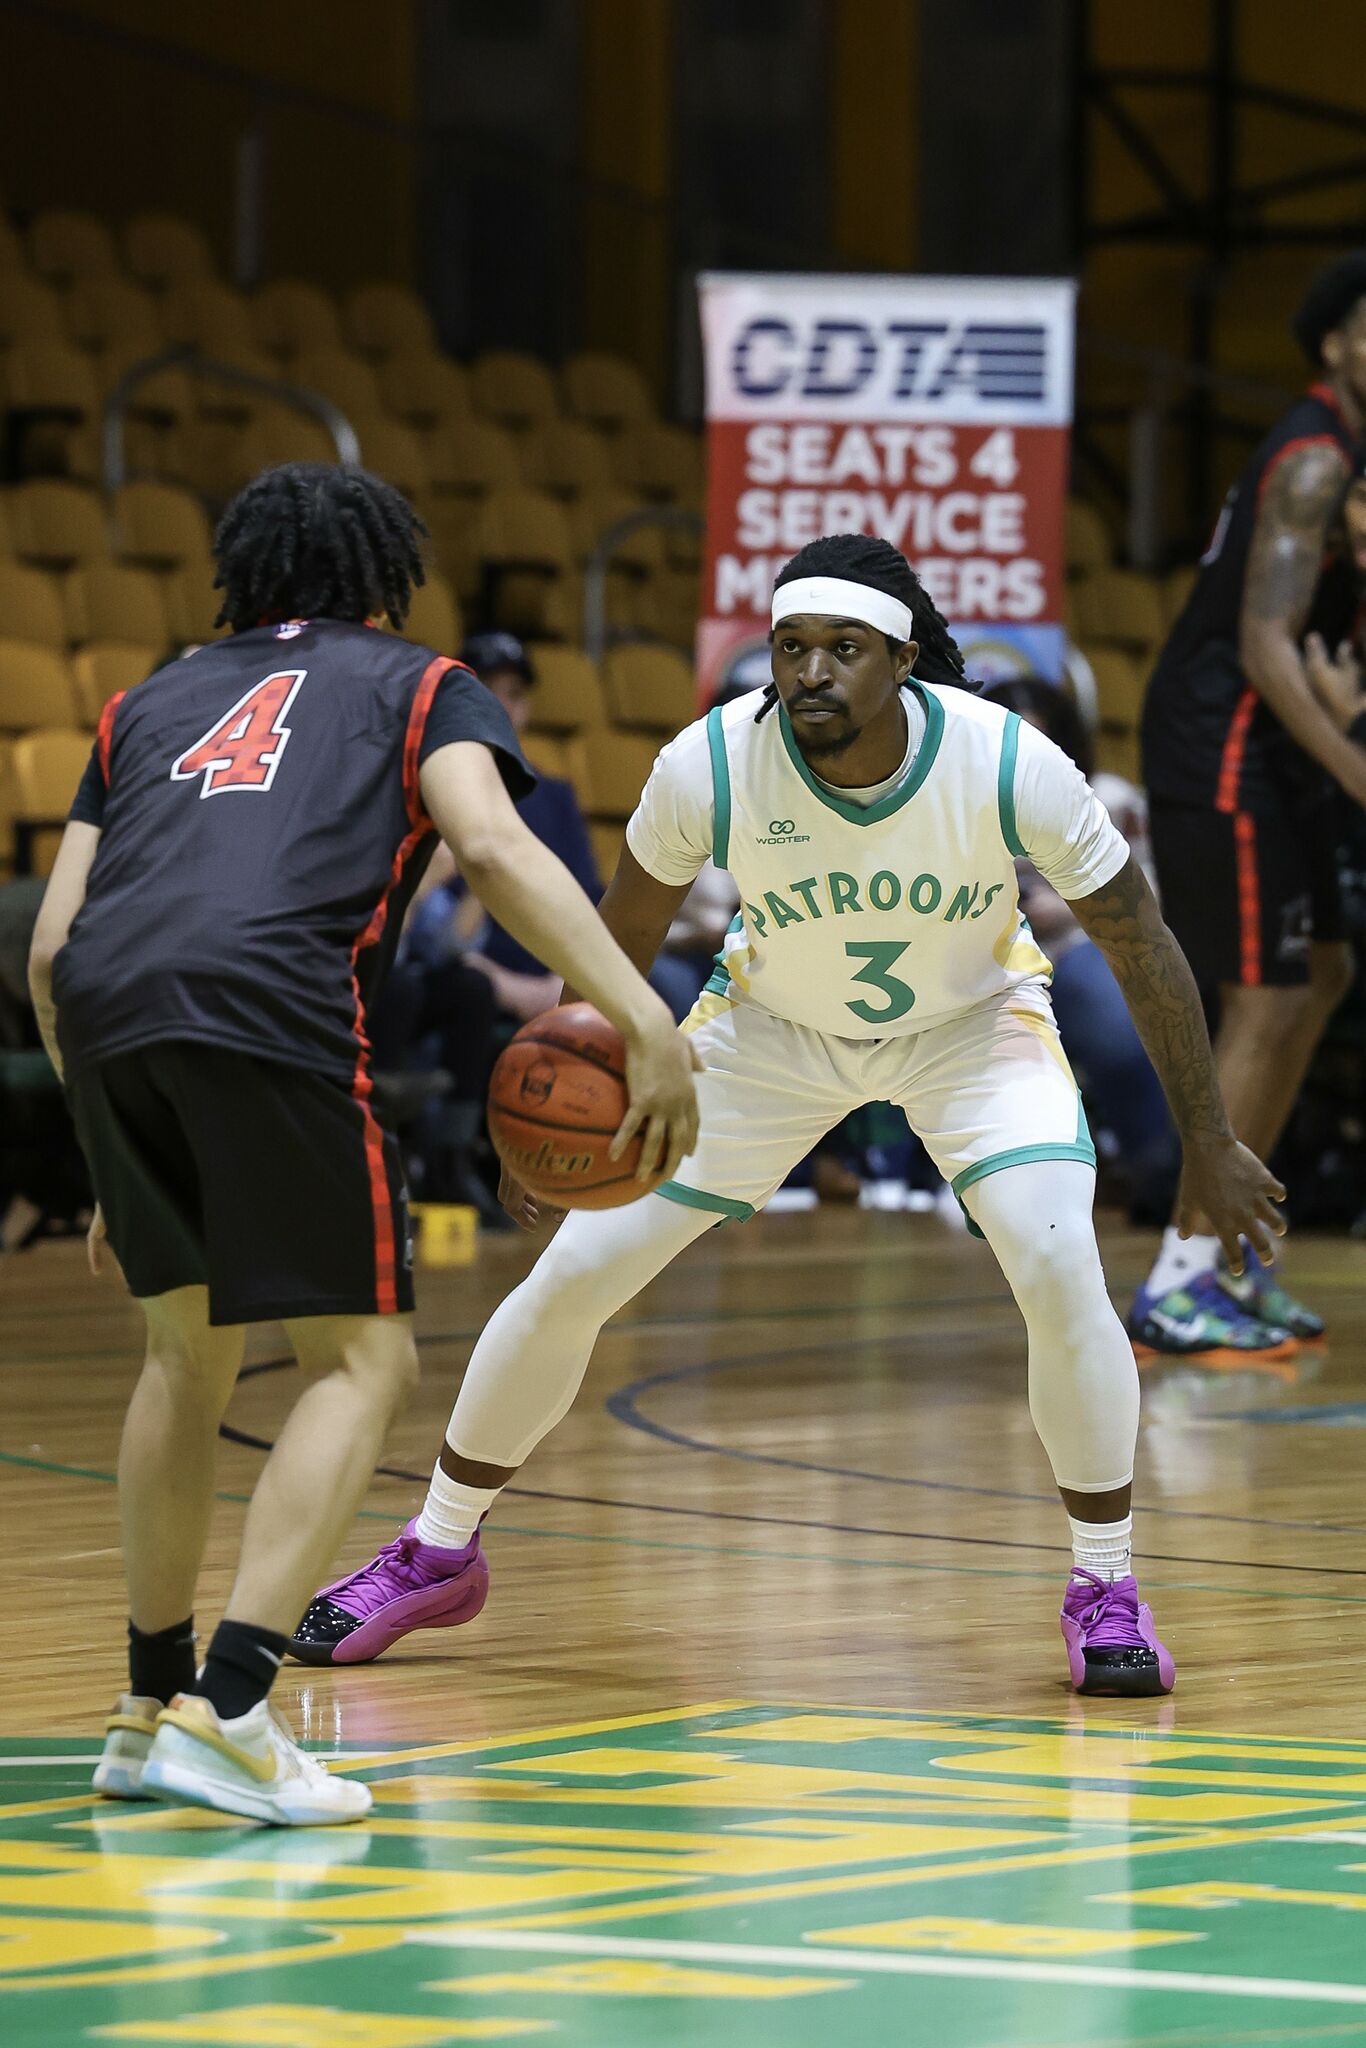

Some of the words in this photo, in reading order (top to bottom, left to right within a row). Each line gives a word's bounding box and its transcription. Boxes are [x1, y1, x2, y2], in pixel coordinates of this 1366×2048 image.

[735, 320, 1045, 397] CDTA
[745, 425, 958, 487] SEATS
[969, 427, 1020, 487] 4
[736, 489, 1027, 553] SERVICE
[714, 554, 1047, 619] MERS
[170, 669, 308, 800] 4
[756, 835, 811, 845] WOOTER
[745, 870, 1004, 938] PATROONS
[844, 941, 916, 1024] 3
